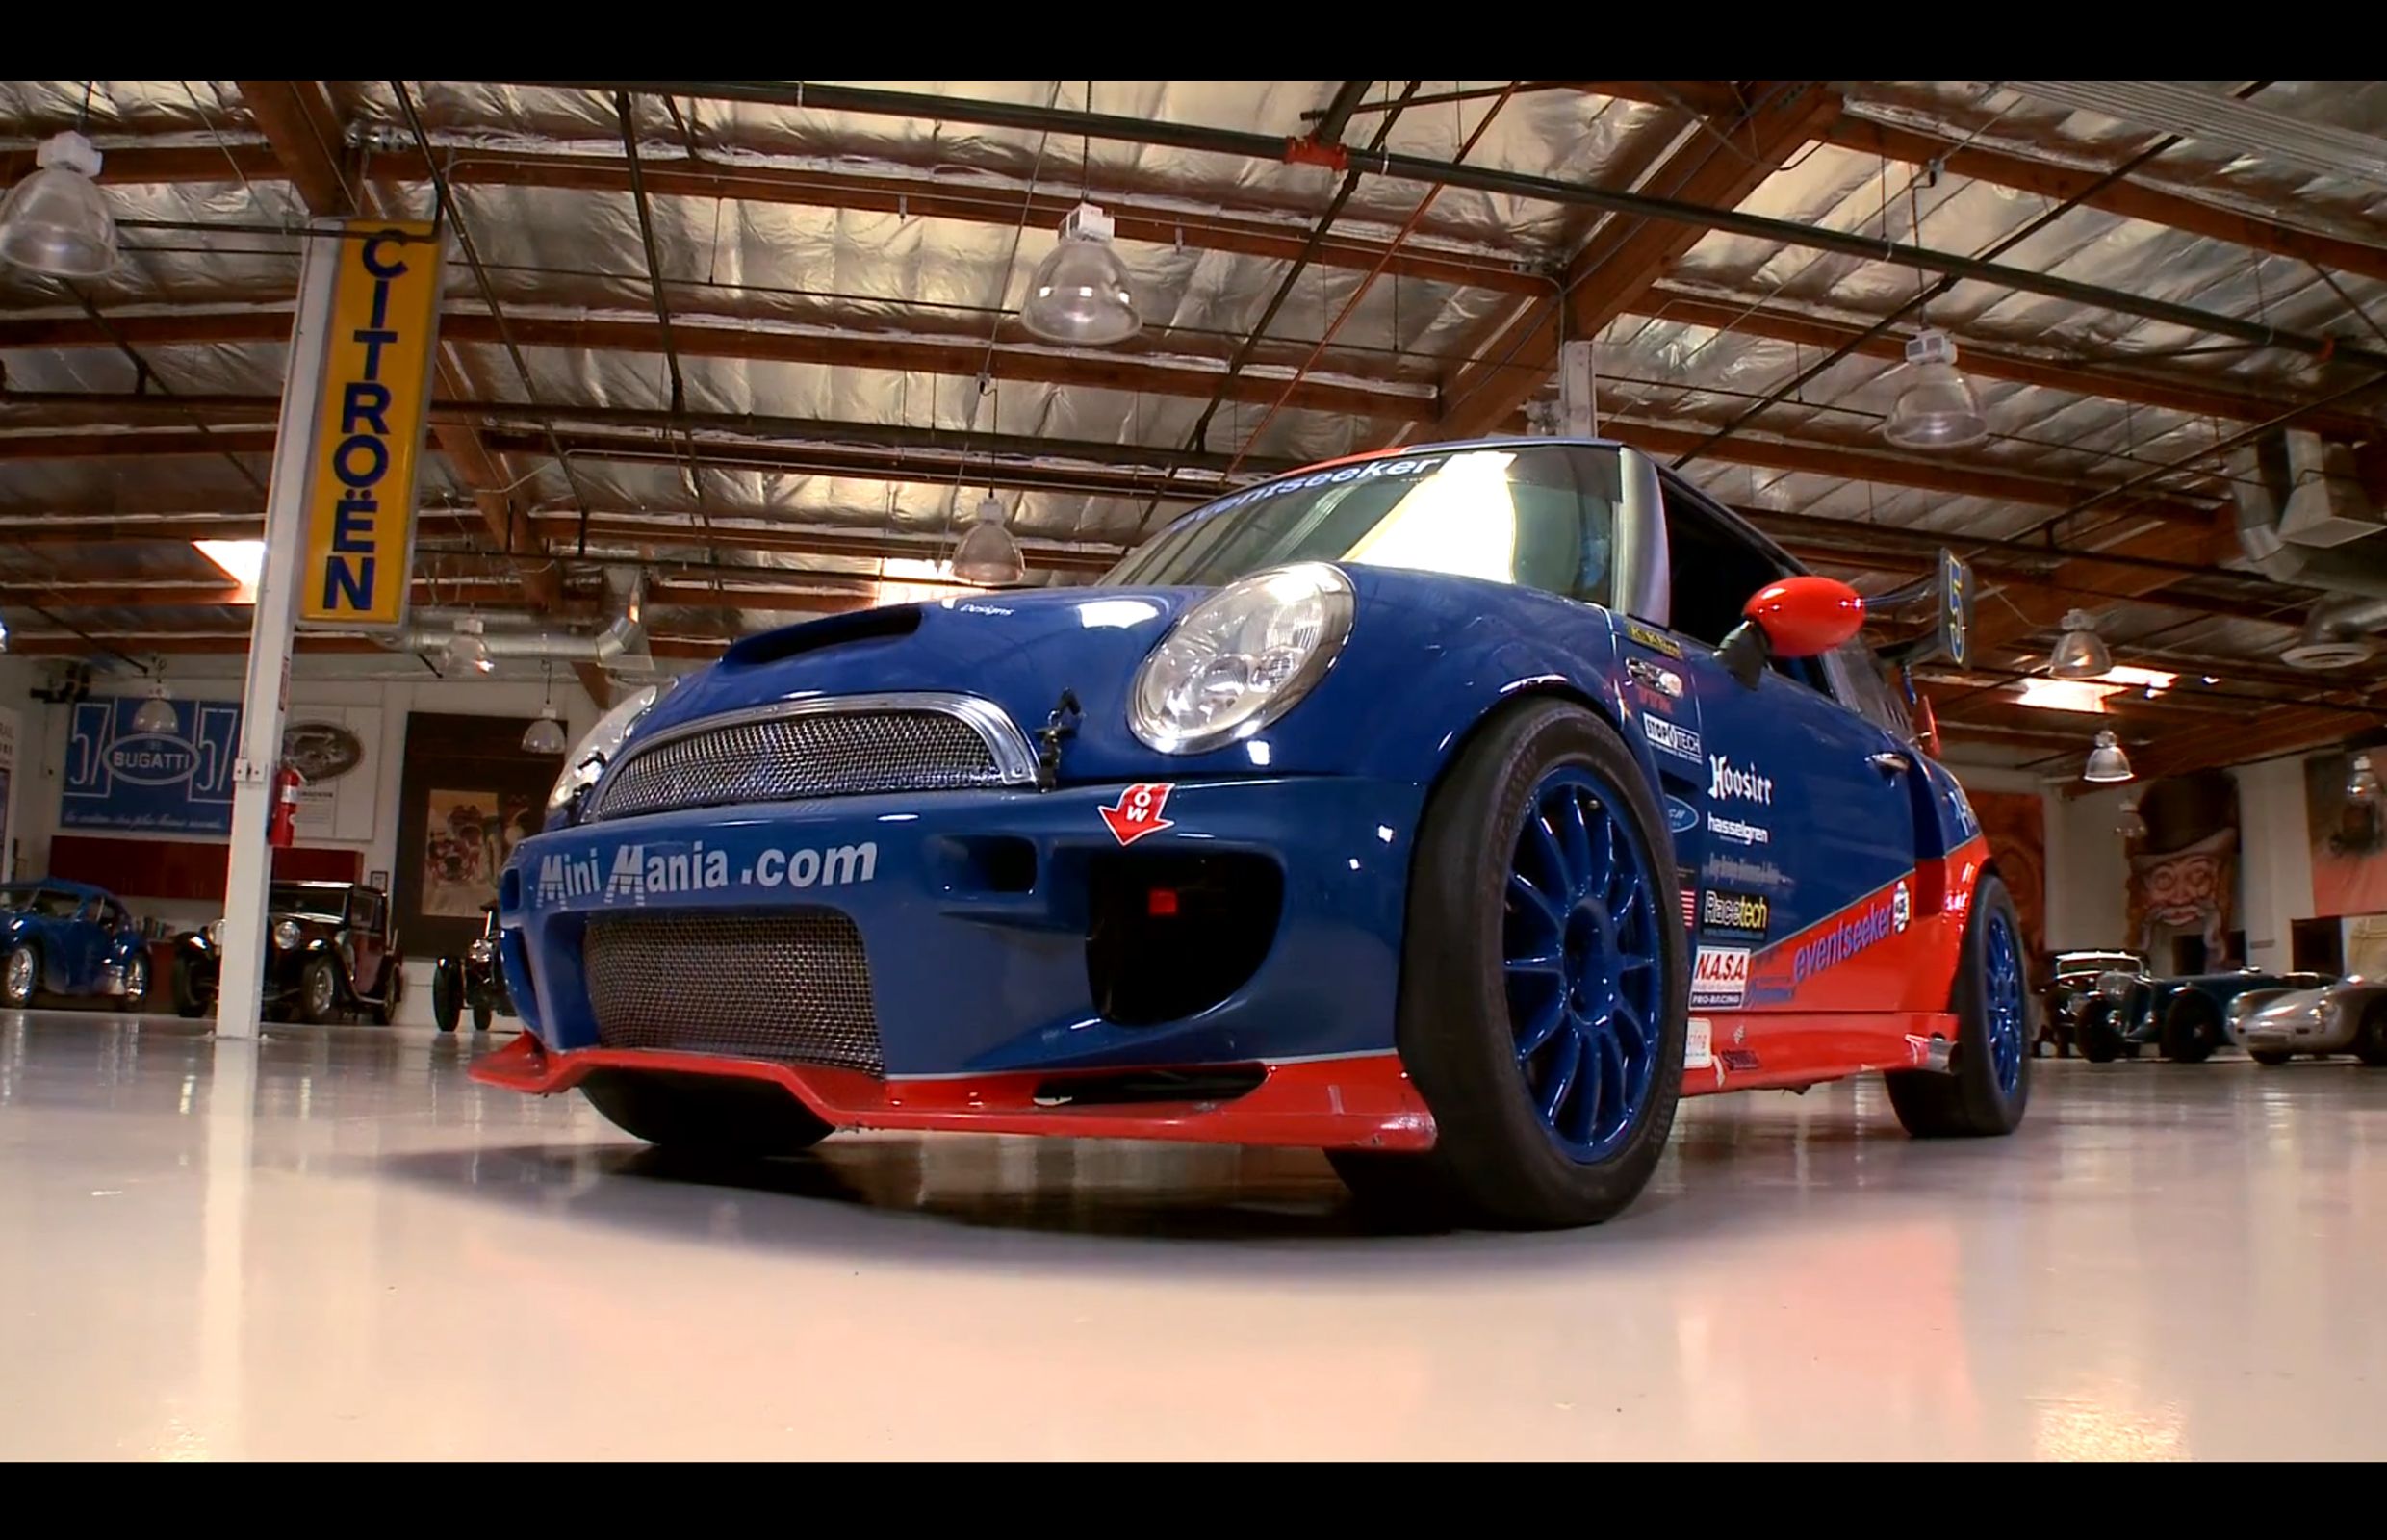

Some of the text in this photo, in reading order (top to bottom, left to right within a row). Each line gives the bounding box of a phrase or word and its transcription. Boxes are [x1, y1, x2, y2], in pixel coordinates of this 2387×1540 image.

[322, 229, 409, 611] CITROËN
[113, 751, 190, 770] BUGATTI
[1707, 754, 1773, 806] Hoosier
[1707, 811, 1769, 845] hasselgren
[536, 847, 602, 911] Mini
[603, 840, 729, 907] Mania
[1705, 890, 1768, 929] Racetech
[1793, 902, 1892, 983] eventseeker
